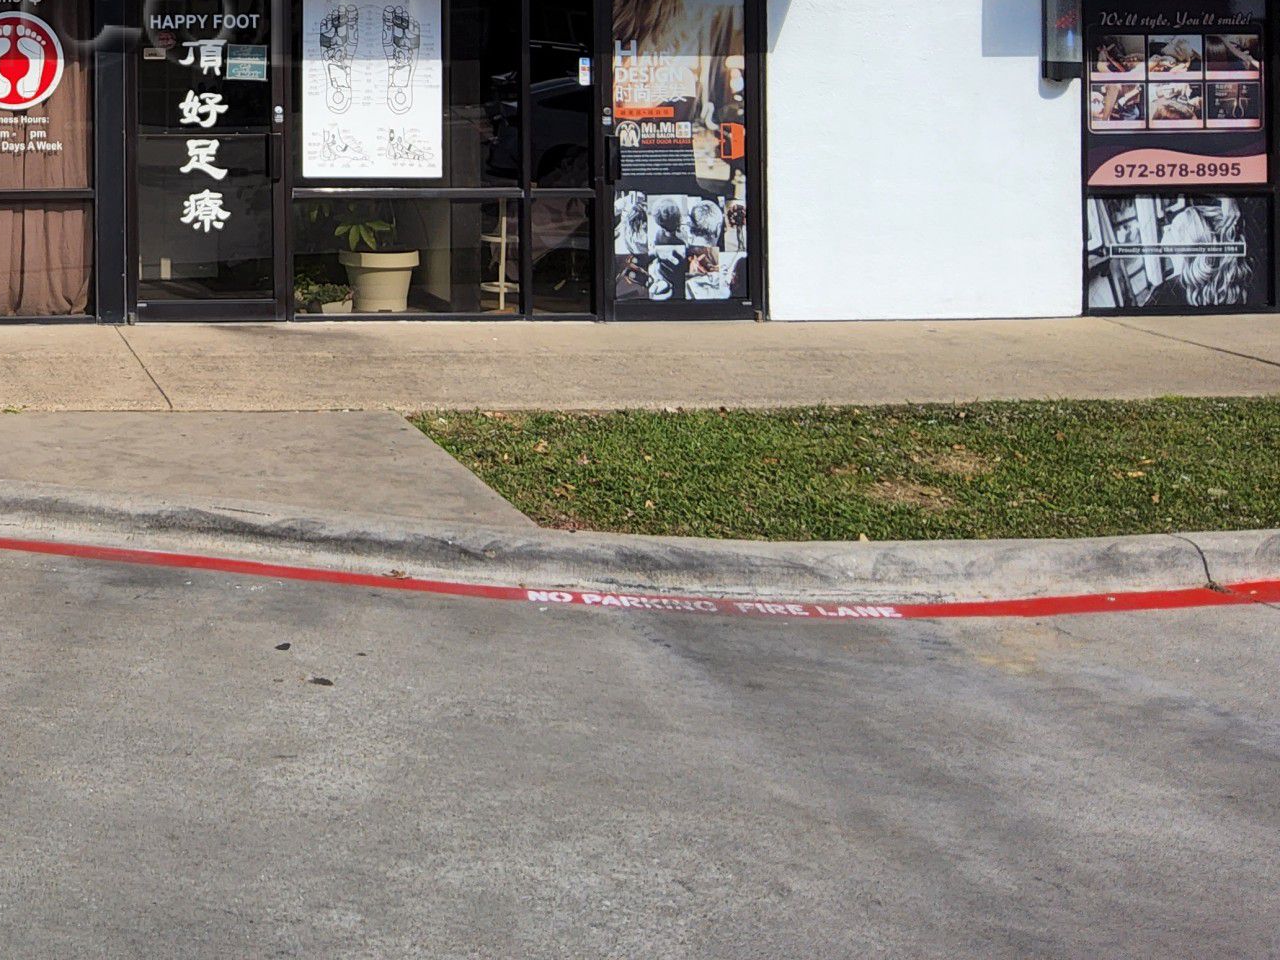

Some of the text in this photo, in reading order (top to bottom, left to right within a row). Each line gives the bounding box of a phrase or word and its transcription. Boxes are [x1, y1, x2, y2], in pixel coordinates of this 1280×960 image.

[150, 14, 260, 29] HAPPY FOOT
[1100, 11, 1252, 29] We'll style, You'll smile!
[615, 68, 684, 83] DESIGN
[20, 115, 50, 124] Hours:
[29, 130, 47, 140] pm
[1, 141, 25, 152] Days
[27, 141, 35, 150] A
[36, 141, 63, 151] Week
[1114, 163, 1242, 178] 972-878-8995
[526, 589, 903, 618] NO PARKING FIRE LANE
